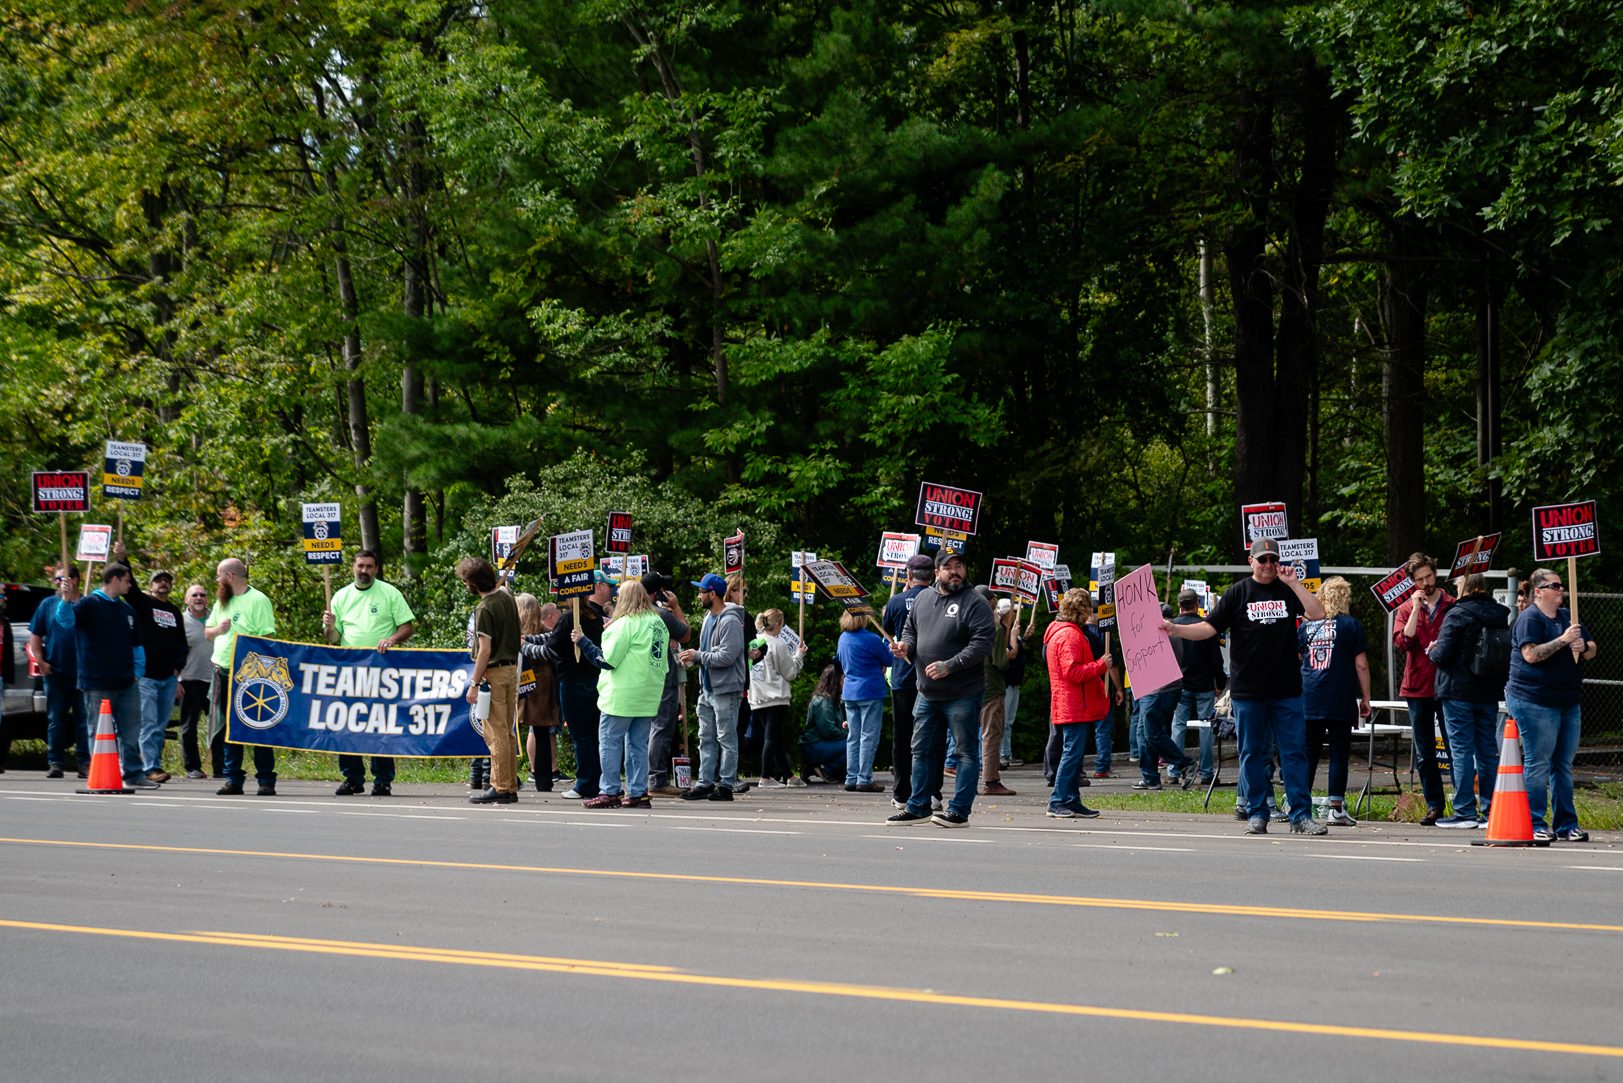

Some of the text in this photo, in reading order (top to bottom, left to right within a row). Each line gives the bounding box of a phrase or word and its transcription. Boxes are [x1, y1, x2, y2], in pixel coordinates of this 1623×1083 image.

[110, 444, 143, 453] TEAMSTERS
[110, 449, 130, 457] LOCAL
[37, 474, 84, 489] UNION
[111, 477, 136, 486] NEEDS
[38, 489, 85, 499] STRONG!
[106, 486, 140, 496] RESPECT
[926, 486, 975, 508] UNION
[39, 500, 84, 510] VOTER
[924, 502, 974, 520] STRONG!
[1540, 504, 1593, 528] UNION
[924, 512, 971, 531] VOTER
[1252, 514, 1284, 528] UNION
[559, 533, 590, 544] TEAMSTERS
[1542, 525, 1594, 542] STRONG!
[311, 541, 335, 549] NEEDS
[559, 543, 578, 552] LOCAL
[1280, 542, 1314, 551] TEAMSTERS
[1543, 538, 1595, 557] VOTER
[307, 551, 340, 560] RESPECT
[559, 551, 568, 559] 317
[563, 561, 588, 571] NEEDS
[571, 573, 589, 582] FAIR
[559, 584, 593, 596] CONTRACT
[1116, 572, 1157, 613] HONK
[1249, 601, 1283, 612] UNION
[1251, 610, 1284, 618] STRONG!
[1130, 611, 1145, 638] for
[299, 662, 468, 700] TEAMSTERS
[308, 699, 403, 735] LOCAL
[408, 704, 452, 735] 317
